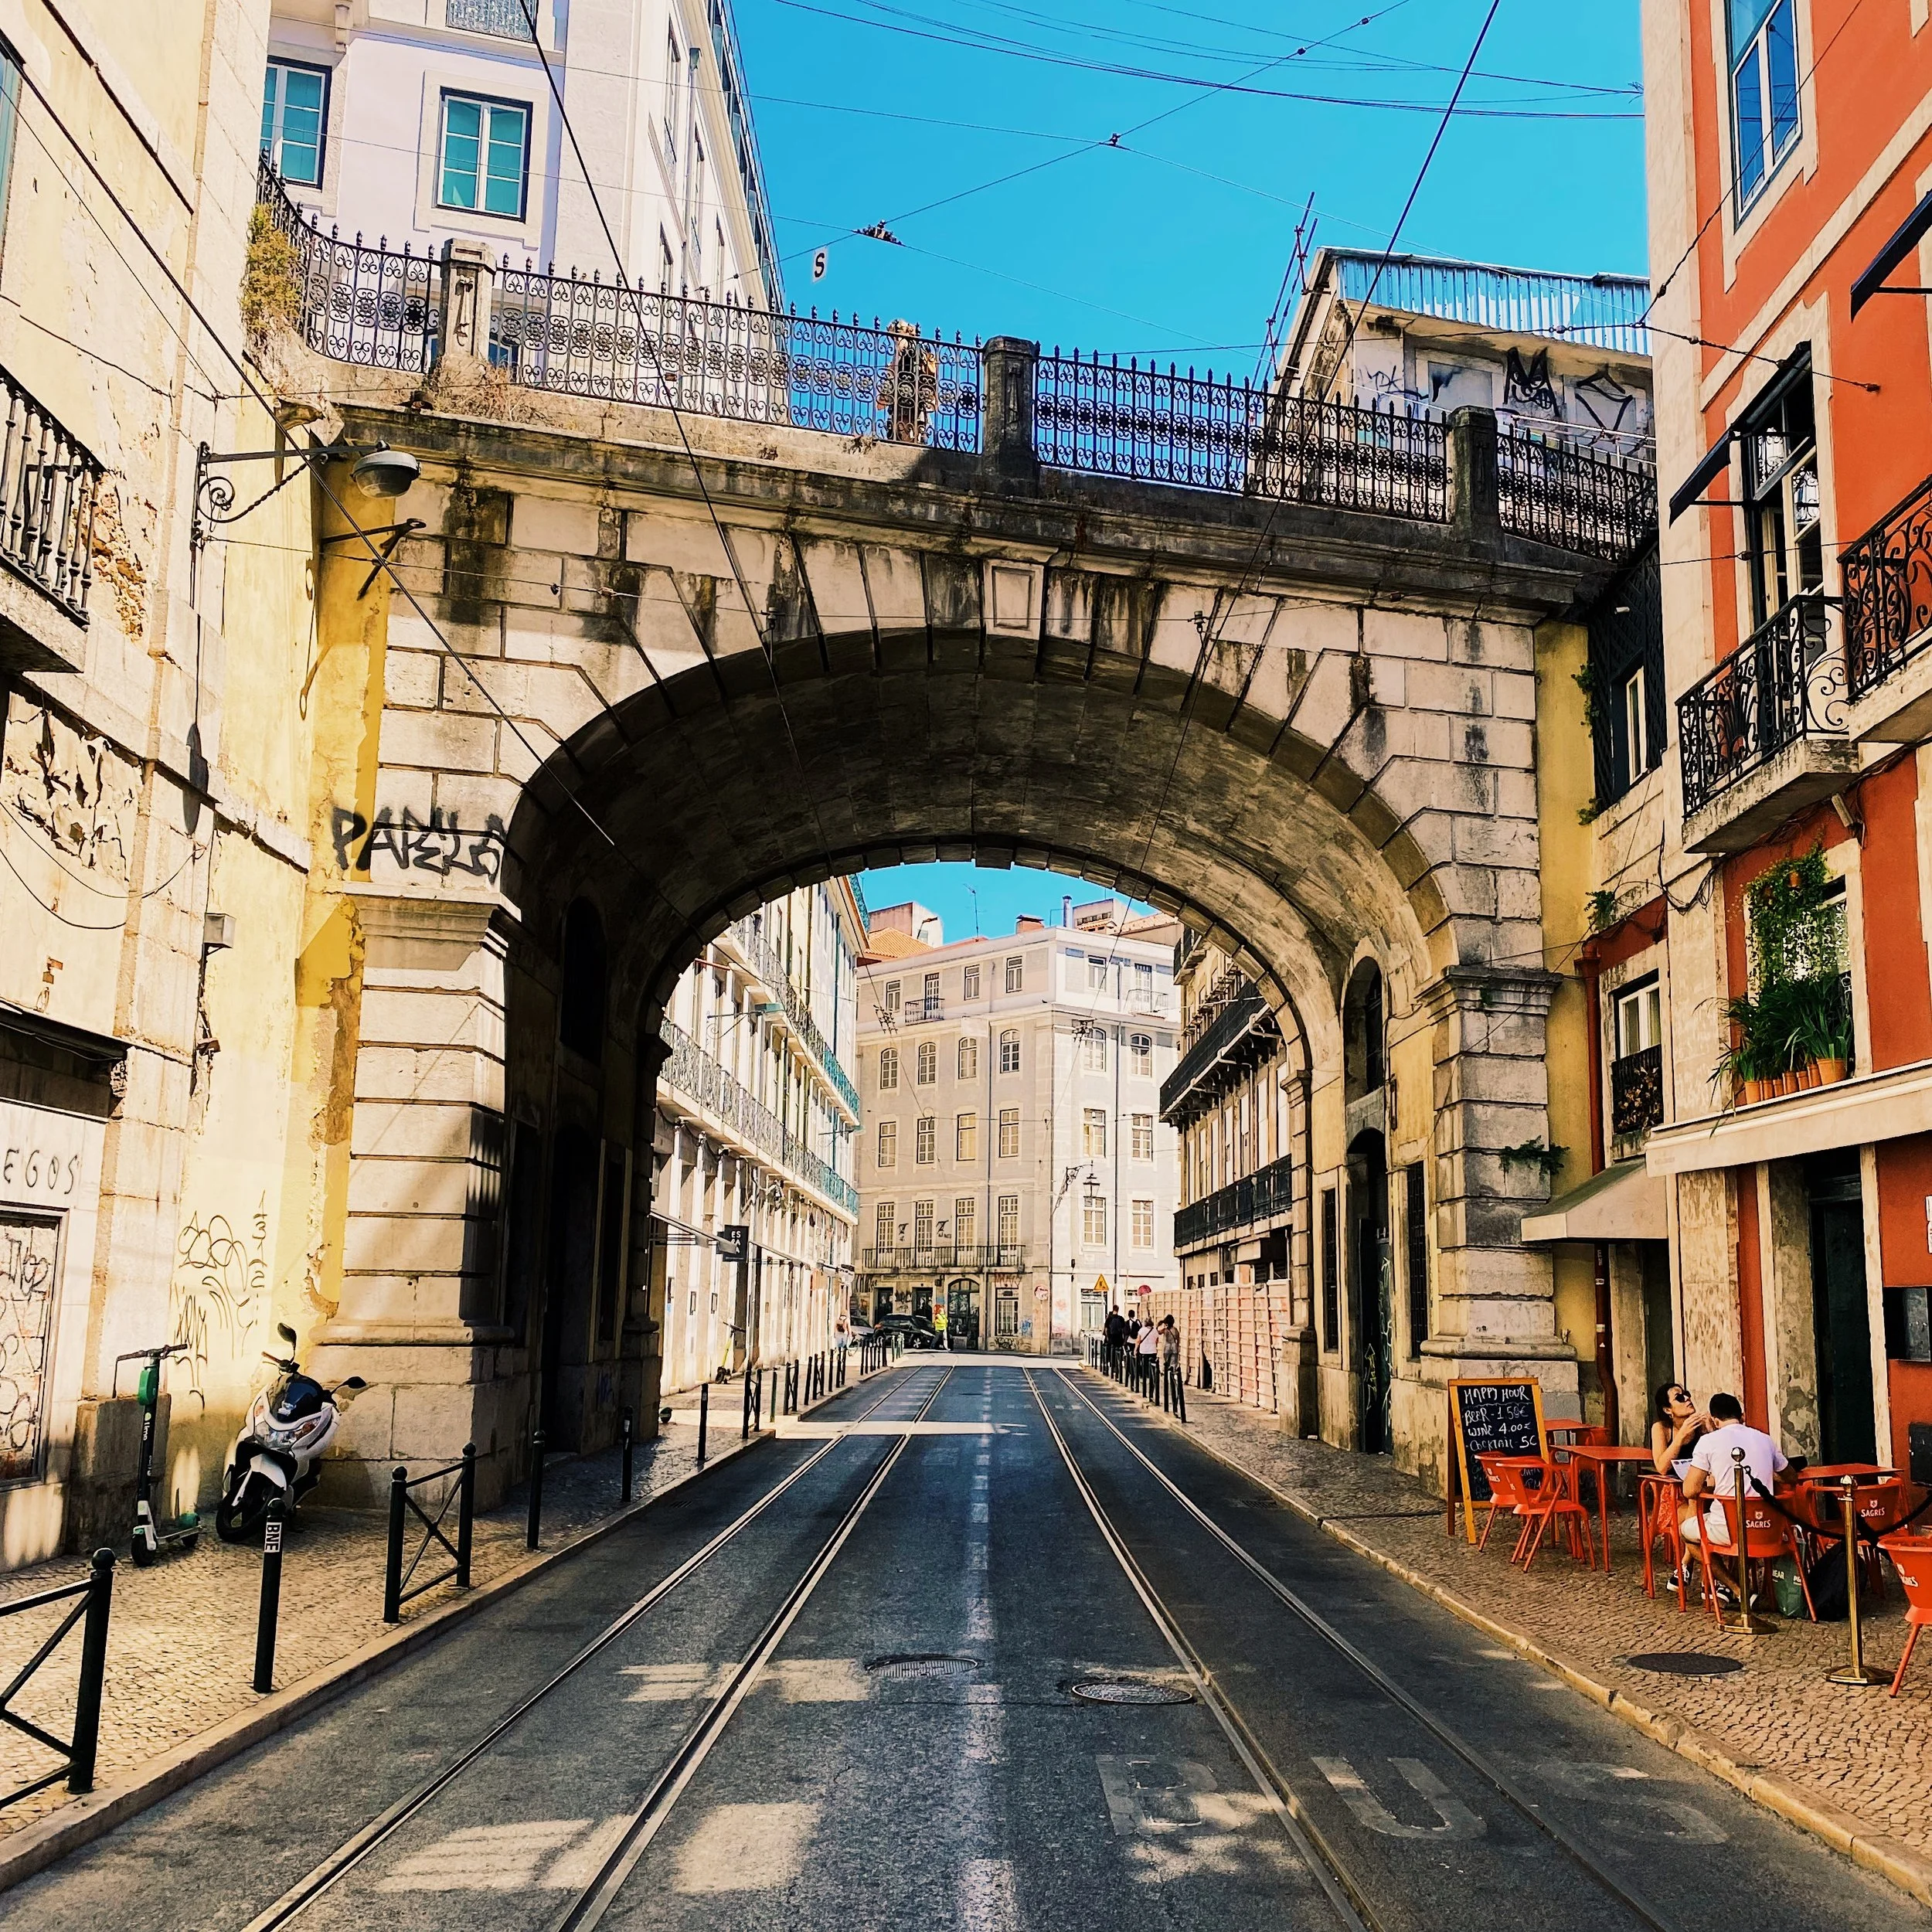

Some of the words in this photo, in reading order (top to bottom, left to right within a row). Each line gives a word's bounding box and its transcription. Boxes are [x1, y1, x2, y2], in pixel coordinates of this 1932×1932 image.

[1464, 1386, 1498, 1405] HAPPY
[1502, 1385, 1530, 1403] HOUR
[1464, 1407, 1491, 1427] BEER
[1468, 1423, 1494, 1436] WINE
[1861, 1507, 1885, 1517] SAGRES
[1746, 1519, 1771, 1528] SAGRES
